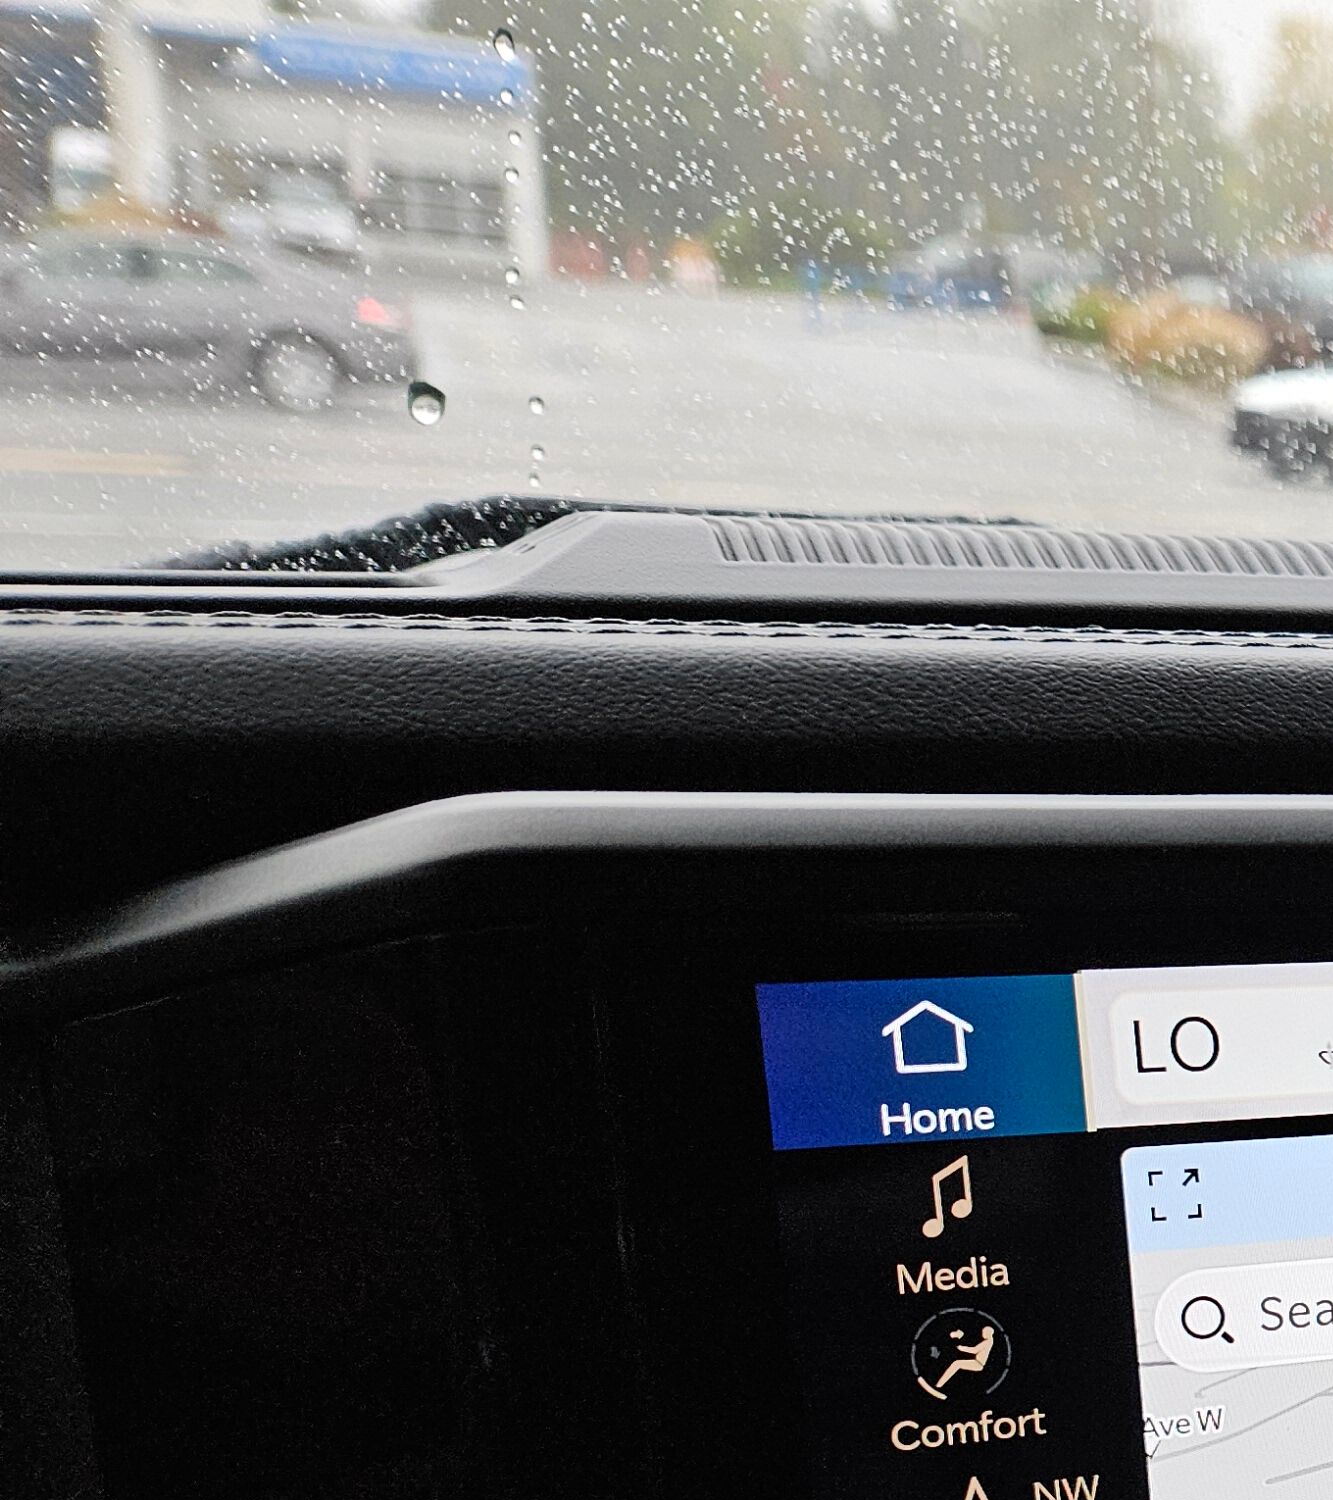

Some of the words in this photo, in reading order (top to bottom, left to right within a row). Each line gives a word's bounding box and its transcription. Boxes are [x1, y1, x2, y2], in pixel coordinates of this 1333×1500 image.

[1133, 1015, 1221, 1074] LO
[881, 1103, 995, 1136] Home
[896, 1257, 1010, 1295] Media
[891, 1408, 1047, 1451] Comfort
[1143, 1417, 1190, 1438] Ave
[1196, 1408, 1222, 1432] W
